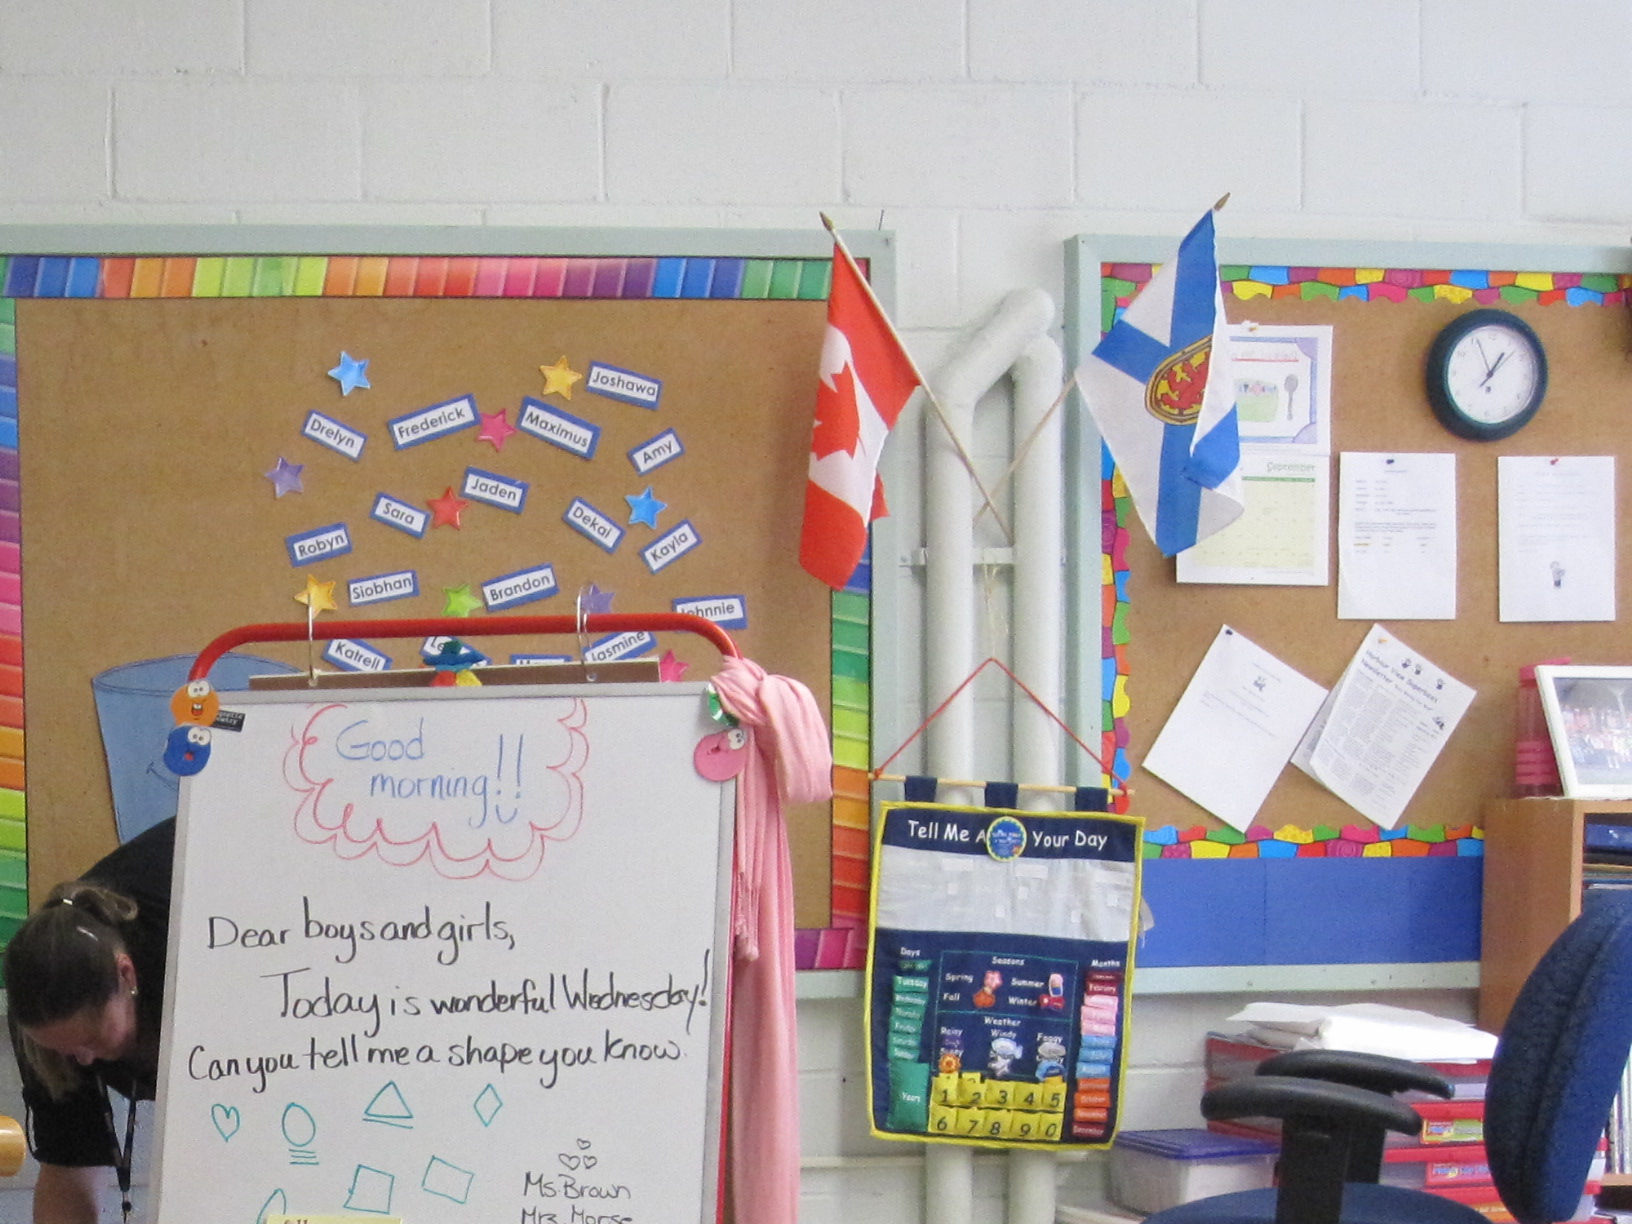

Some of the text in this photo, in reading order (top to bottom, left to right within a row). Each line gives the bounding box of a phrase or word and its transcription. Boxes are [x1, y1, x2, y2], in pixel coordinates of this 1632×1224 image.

[592, 371, 656, 396] Joshawa
[310, 418, 355, 448] Drelyn
[397, 407, 466, 439] Frederick
[525, 410, 589, 448] Maximus
[642, 440, 673, 464] Amy
[470, 477, 517, 501] Jaden
[382, 502, 415, 525] Sara
[298, 533, 345, 558] Robyn
[650, 531, 689, 562] Kayla
[352, 576, 413, 600] Siobhan
[490, 572, 551, 601] Brandon
[335, 641, 381, 671] Katrell
[336, 717, 425, 762] Good
[908, 819, 939, 840] Tell
[943, 823, 971, 843] Me
[1032, 831, 1069, 848] Your
[1074, 829, 1108, 851] Day
[207, 895, 516, 966] Dear boys and girls,
[900, 946, 920, 957] Days
[992, 956, 1025, 966] Seasons
[1090, 959, 1121, 968] Months
[945, 972, 1045, 988] Spring Summer
[259, 966, 382, 1038] Today
[390, 985, 421, 1016] is
[430, 972, 555, 1015] wonderful
[943, 993, 1038, 1006] Fall Winter
[984, 1016, 1021, 1027] Weather
[990, 1028, 1017, 1040] Windy
[187, 1044, 241, 1081] Can
[246, 1053, 300, 1094] you
[301, 1033, 359, 1070] tell
[368, 1046, 410, 1066] me
[415, 1044, 441, 1064] a
[447, 1034, 533, 1074] shape
[538, 1044, 598, 1090] you
[942, 1090, 1061, 1108] 1 2 3 4 5
[936, 1116, 1056, 1138] 6 7 8 9 0
[558, 1173, 631, 1199] Brown
